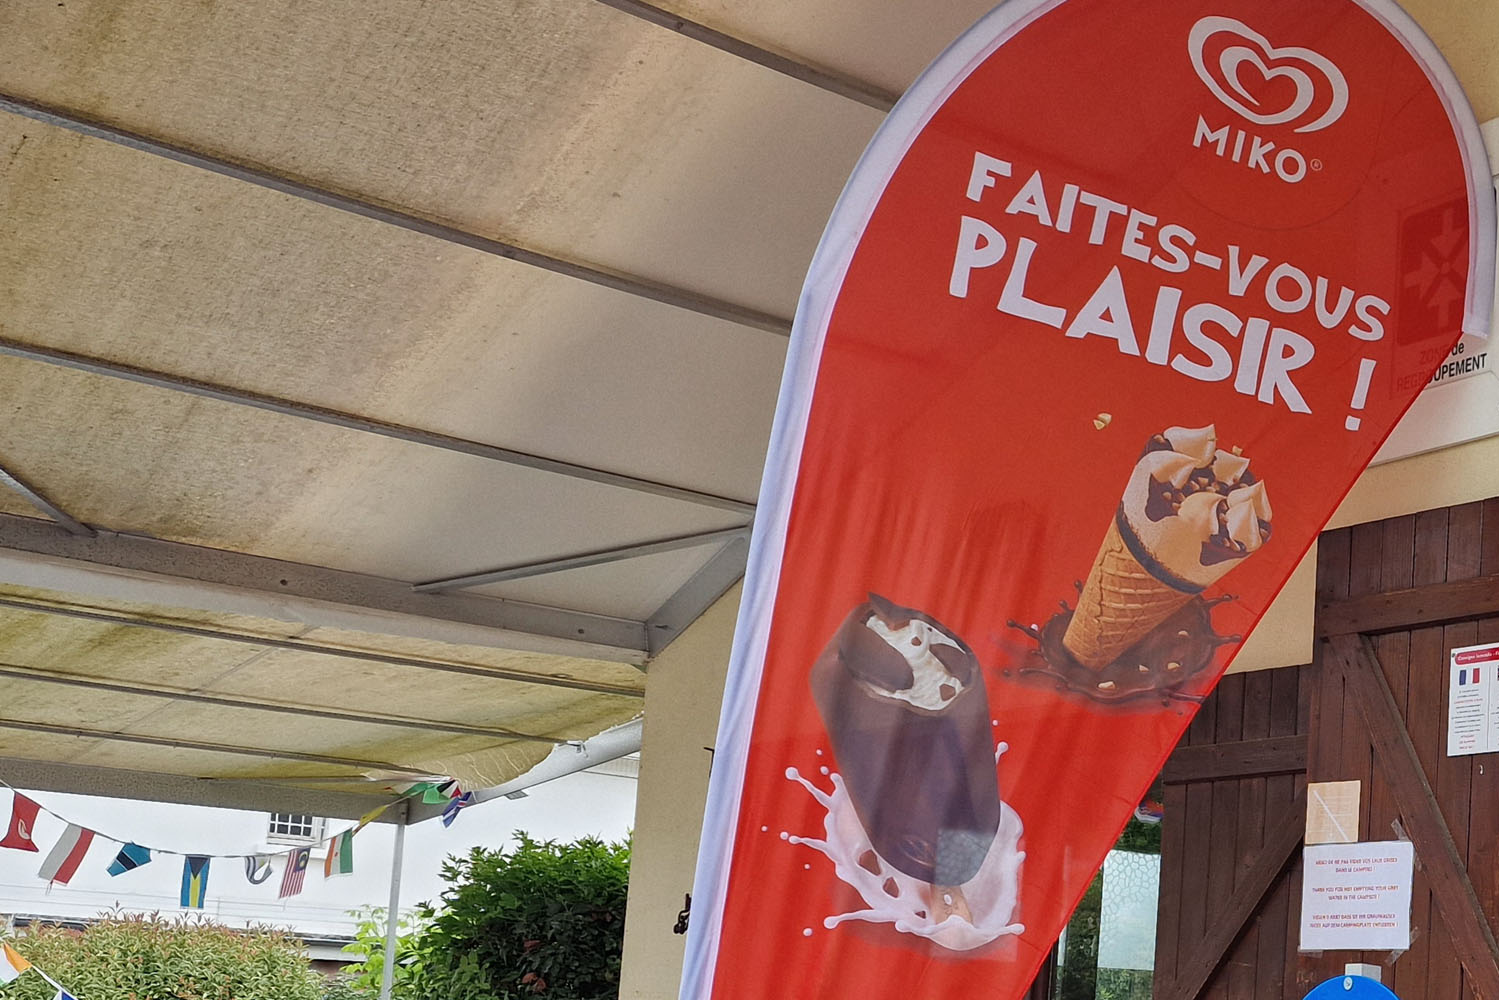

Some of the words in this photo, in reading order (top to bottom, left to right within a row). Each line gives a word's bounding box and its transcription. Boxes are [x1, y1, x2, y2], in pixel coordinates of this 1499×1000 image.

[1192, 114, 1307, 183] MIKO
[949, 215, 1312, 414] PLAISIR
[965, 151, 1391, 341] FAITES-VOUS
